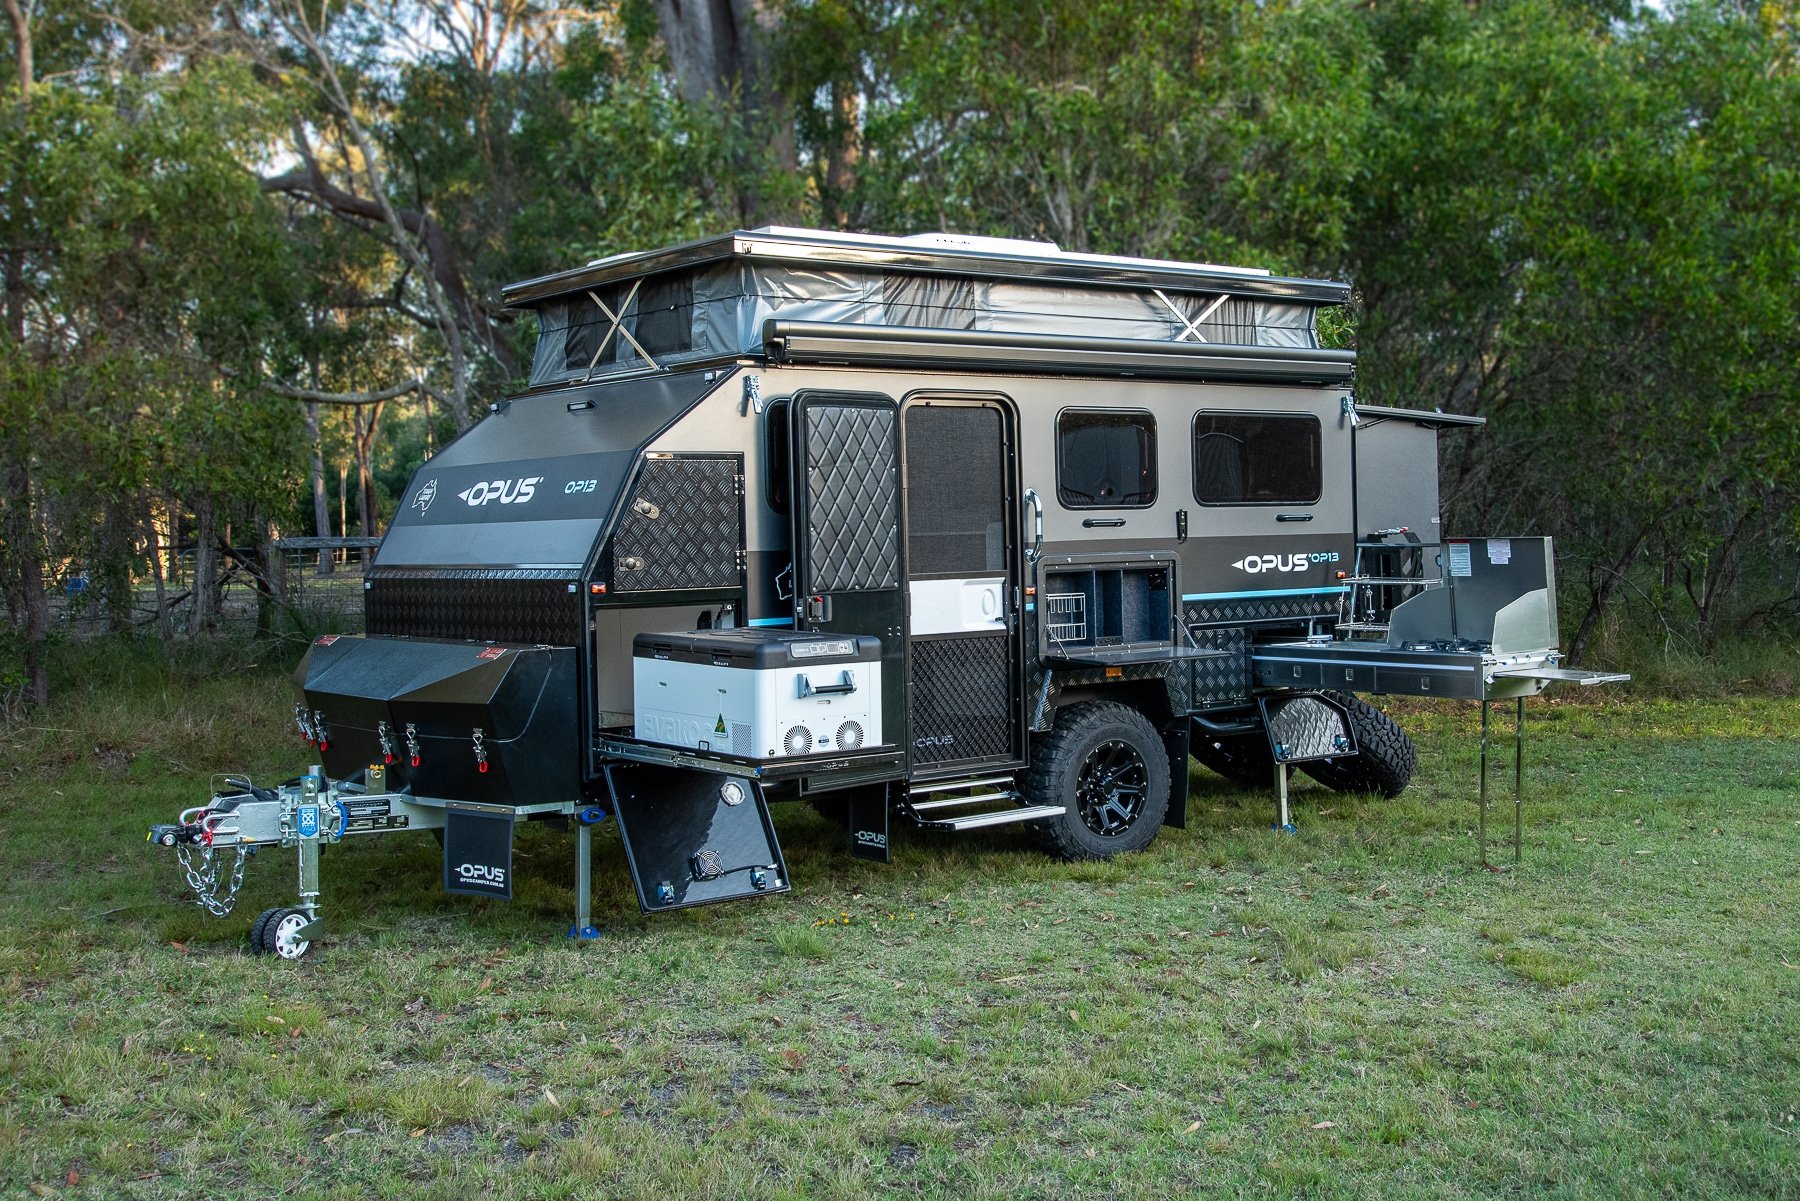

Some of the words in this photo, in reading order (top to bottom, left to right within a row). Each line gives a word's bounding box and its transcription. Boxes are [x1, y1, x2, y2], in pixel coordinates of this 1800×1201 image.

[467, 476, 541, 506] OPUS
[564, 479, 598, 494] OP13
[1243, 553, 1309, 574] OPUS
[1311, 552, 1340, 563] OP13
[858, 830, 886, 844] OPUS
[460, 863, 504, 882] OPUS
